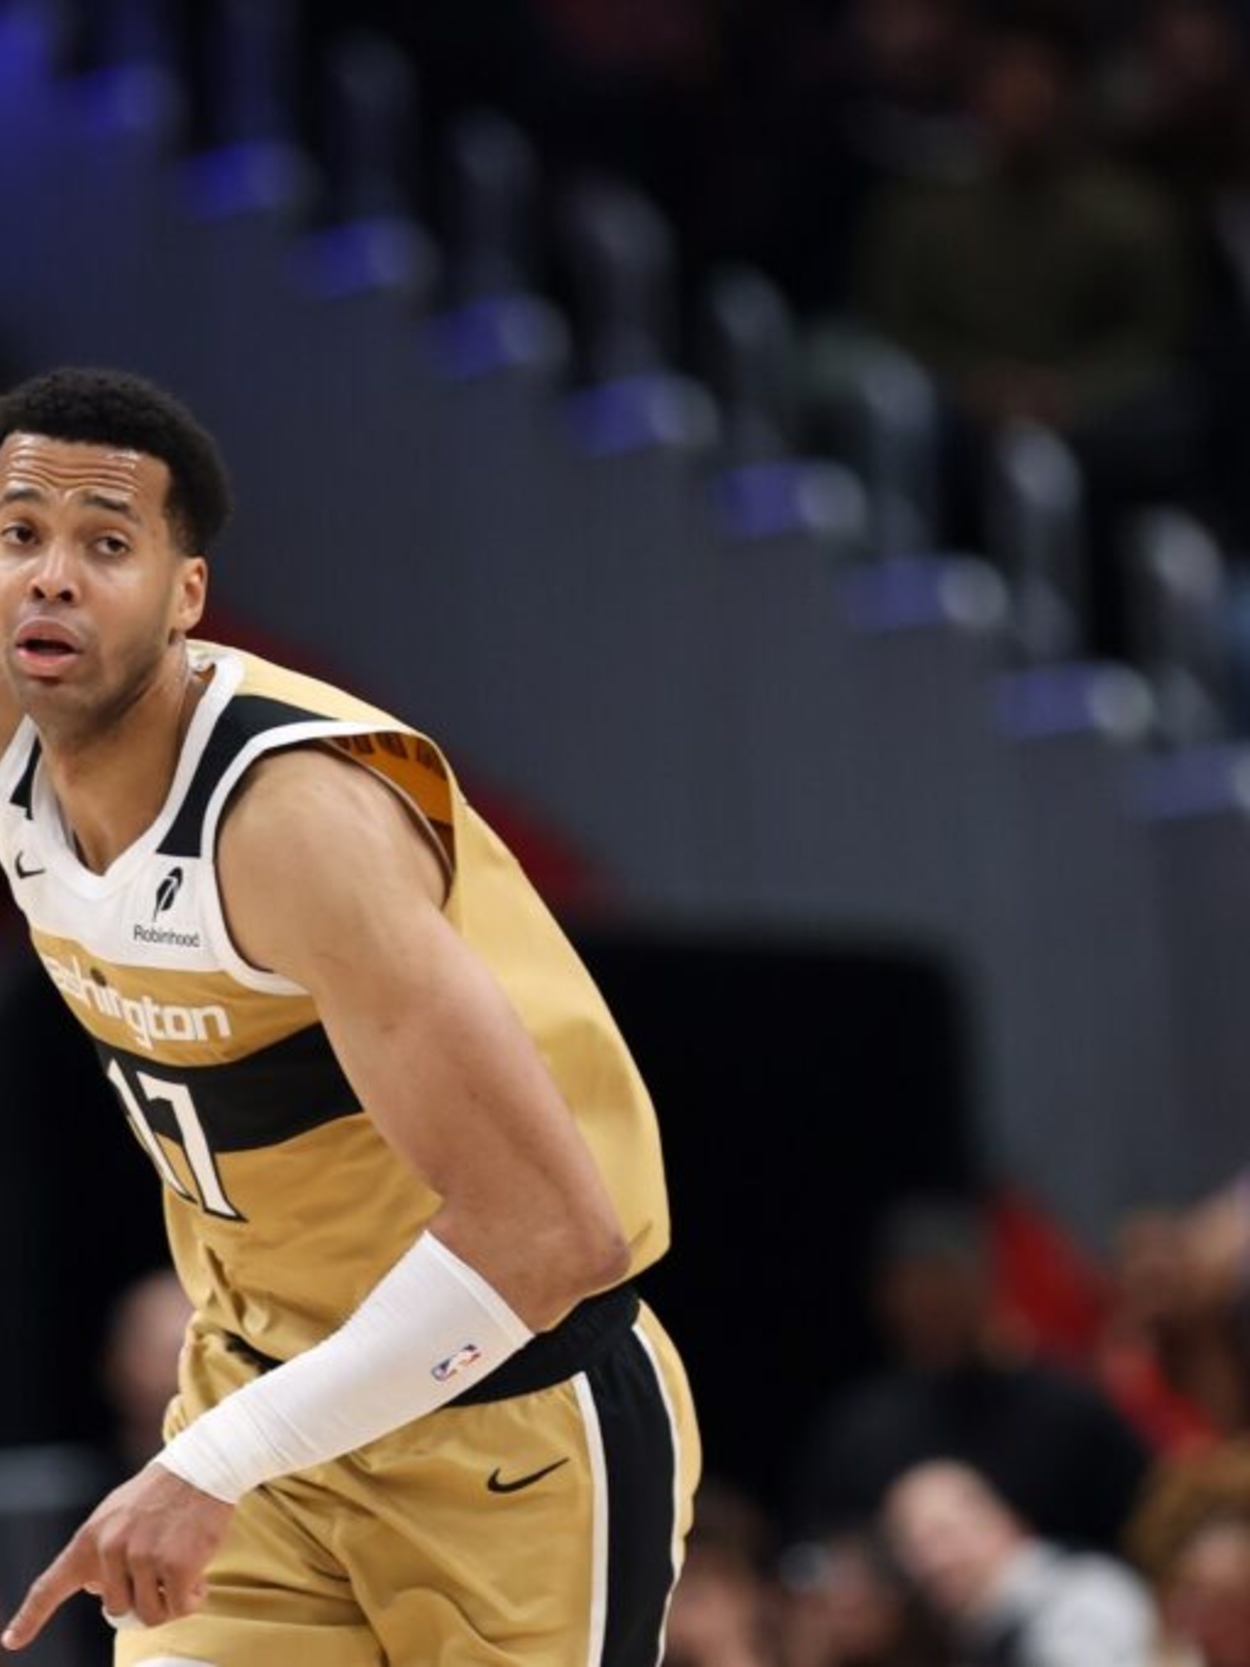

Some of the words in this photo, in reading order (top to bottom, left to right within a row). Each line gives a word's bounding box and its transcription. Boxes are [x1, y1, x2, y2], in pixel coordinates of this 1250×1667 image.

[133, 924, 200, 948] Robinhood
[40, 954, 231, 1049] ashington
[106, 1057, 247, 1221] 17
